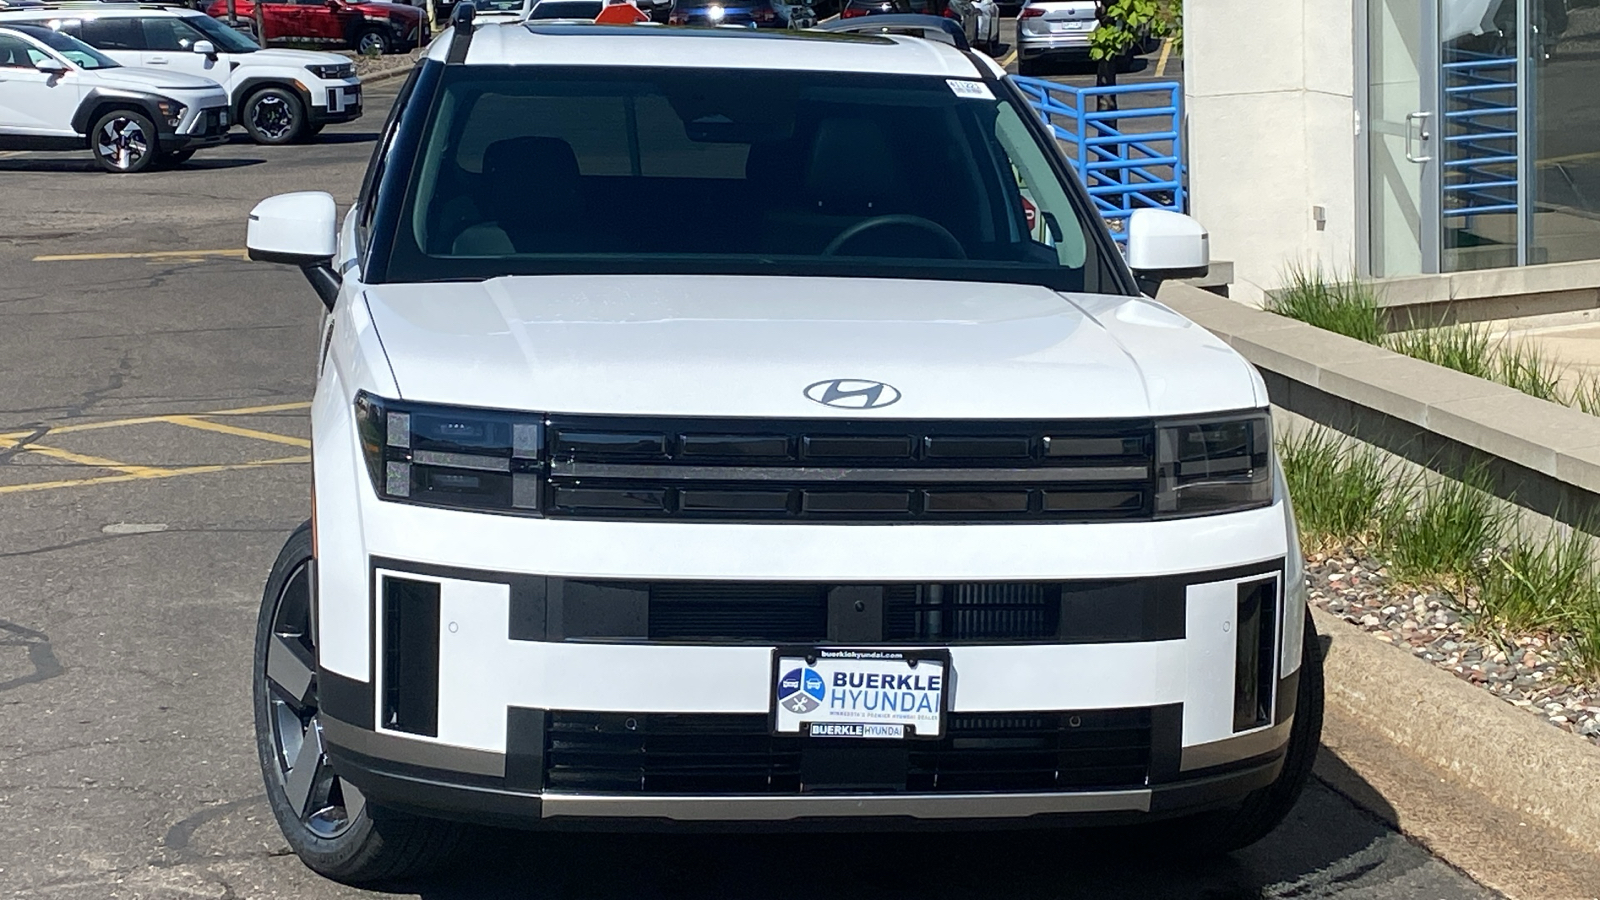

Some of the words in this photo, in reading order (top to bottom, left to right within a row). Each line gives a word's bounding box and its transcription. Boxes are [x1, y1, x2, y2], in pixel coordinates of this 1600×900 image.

[821, 650, 903, 659] buerklehyundai.com
[833, 671, 941, 691] BUERKLE
[830, 689, 940, 713] HYUNDAI
[812, 723, 864, 736] BUERKLE
[864, 725, 902, 737] HYUNDAI
